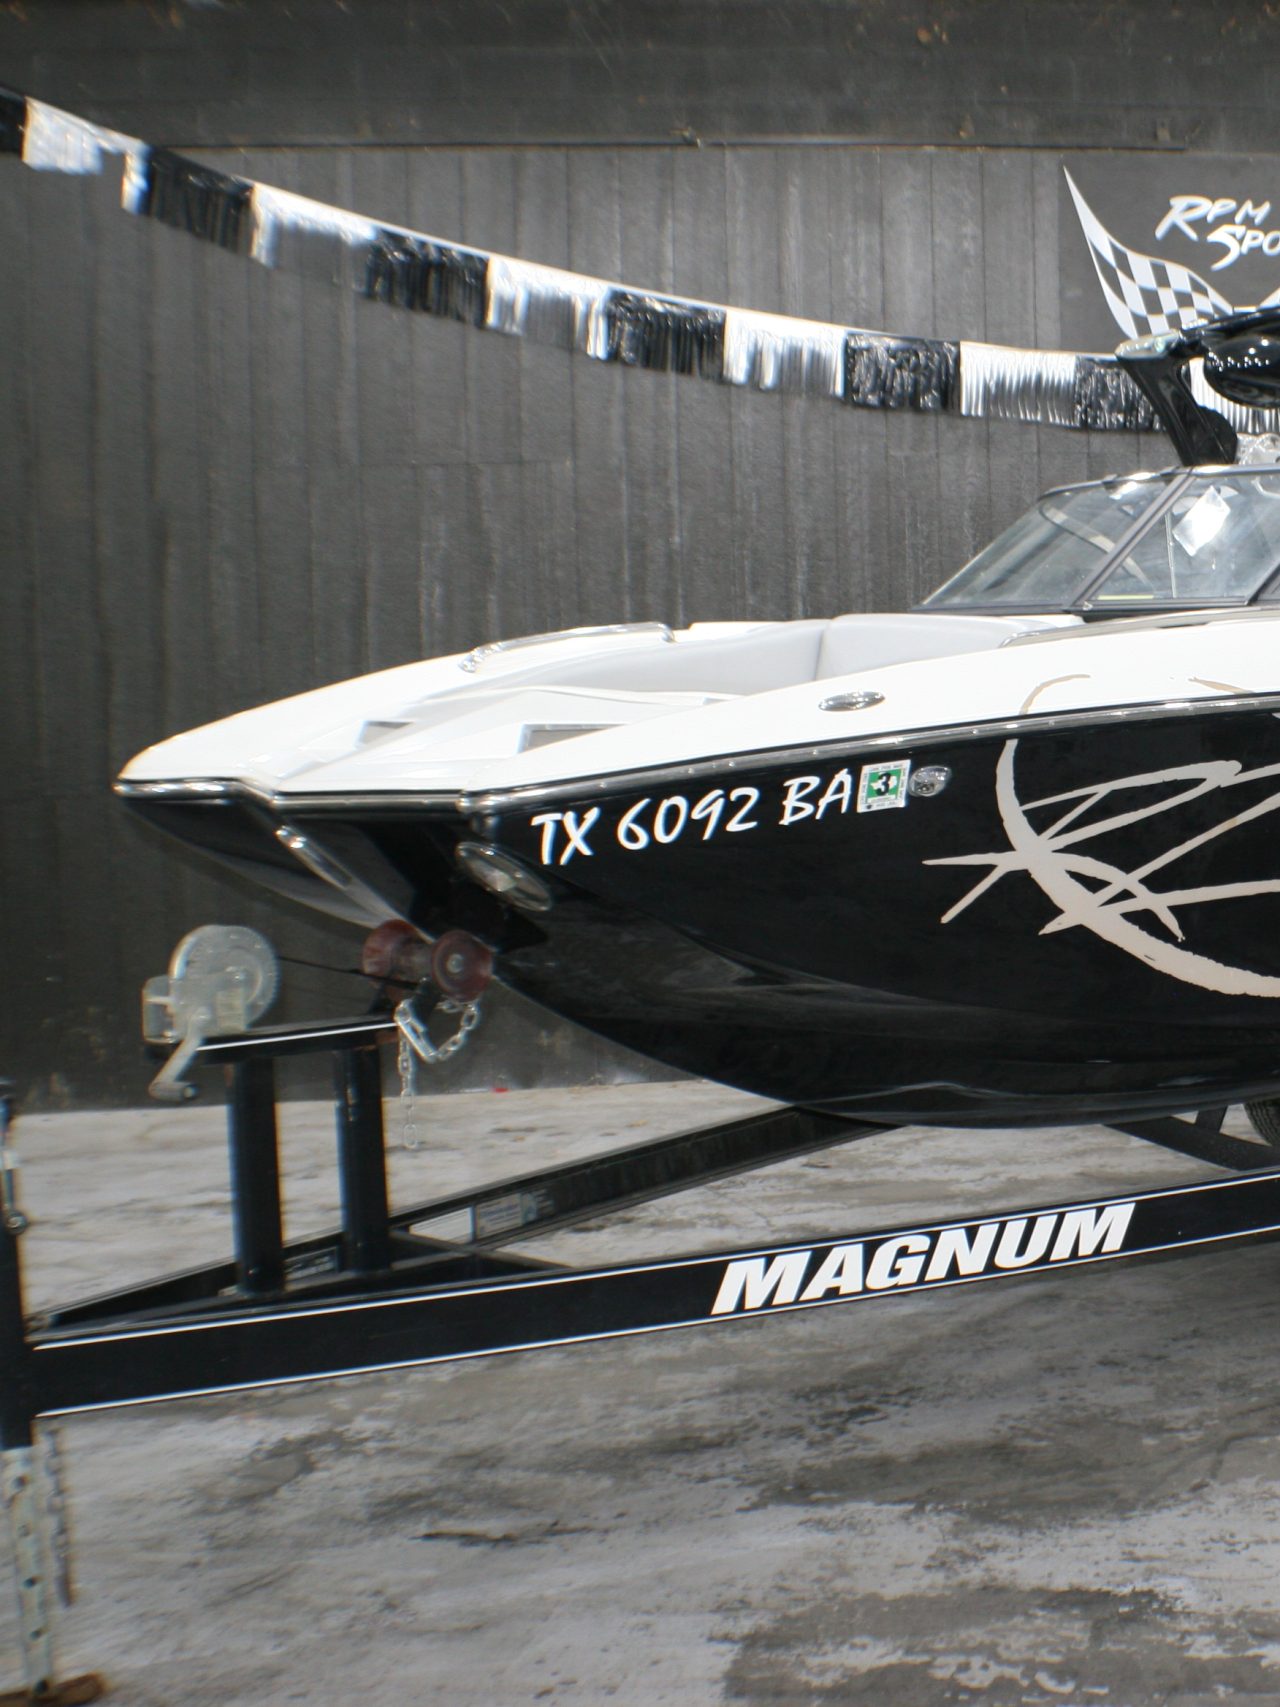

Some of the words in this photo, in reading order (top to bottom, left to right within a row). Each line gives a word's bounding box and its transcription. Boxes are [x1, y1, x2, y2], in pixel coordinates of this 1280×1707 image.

[1155, 195, 1271, 241] RPM
[531, 807, 599, 865] TX
[616, 787, 760, 851] 6092
[779, 769, 853, 826] BA
[875, 772, 892, 796] 3
[710, 1202, 1136, 1315] MAGNUM
